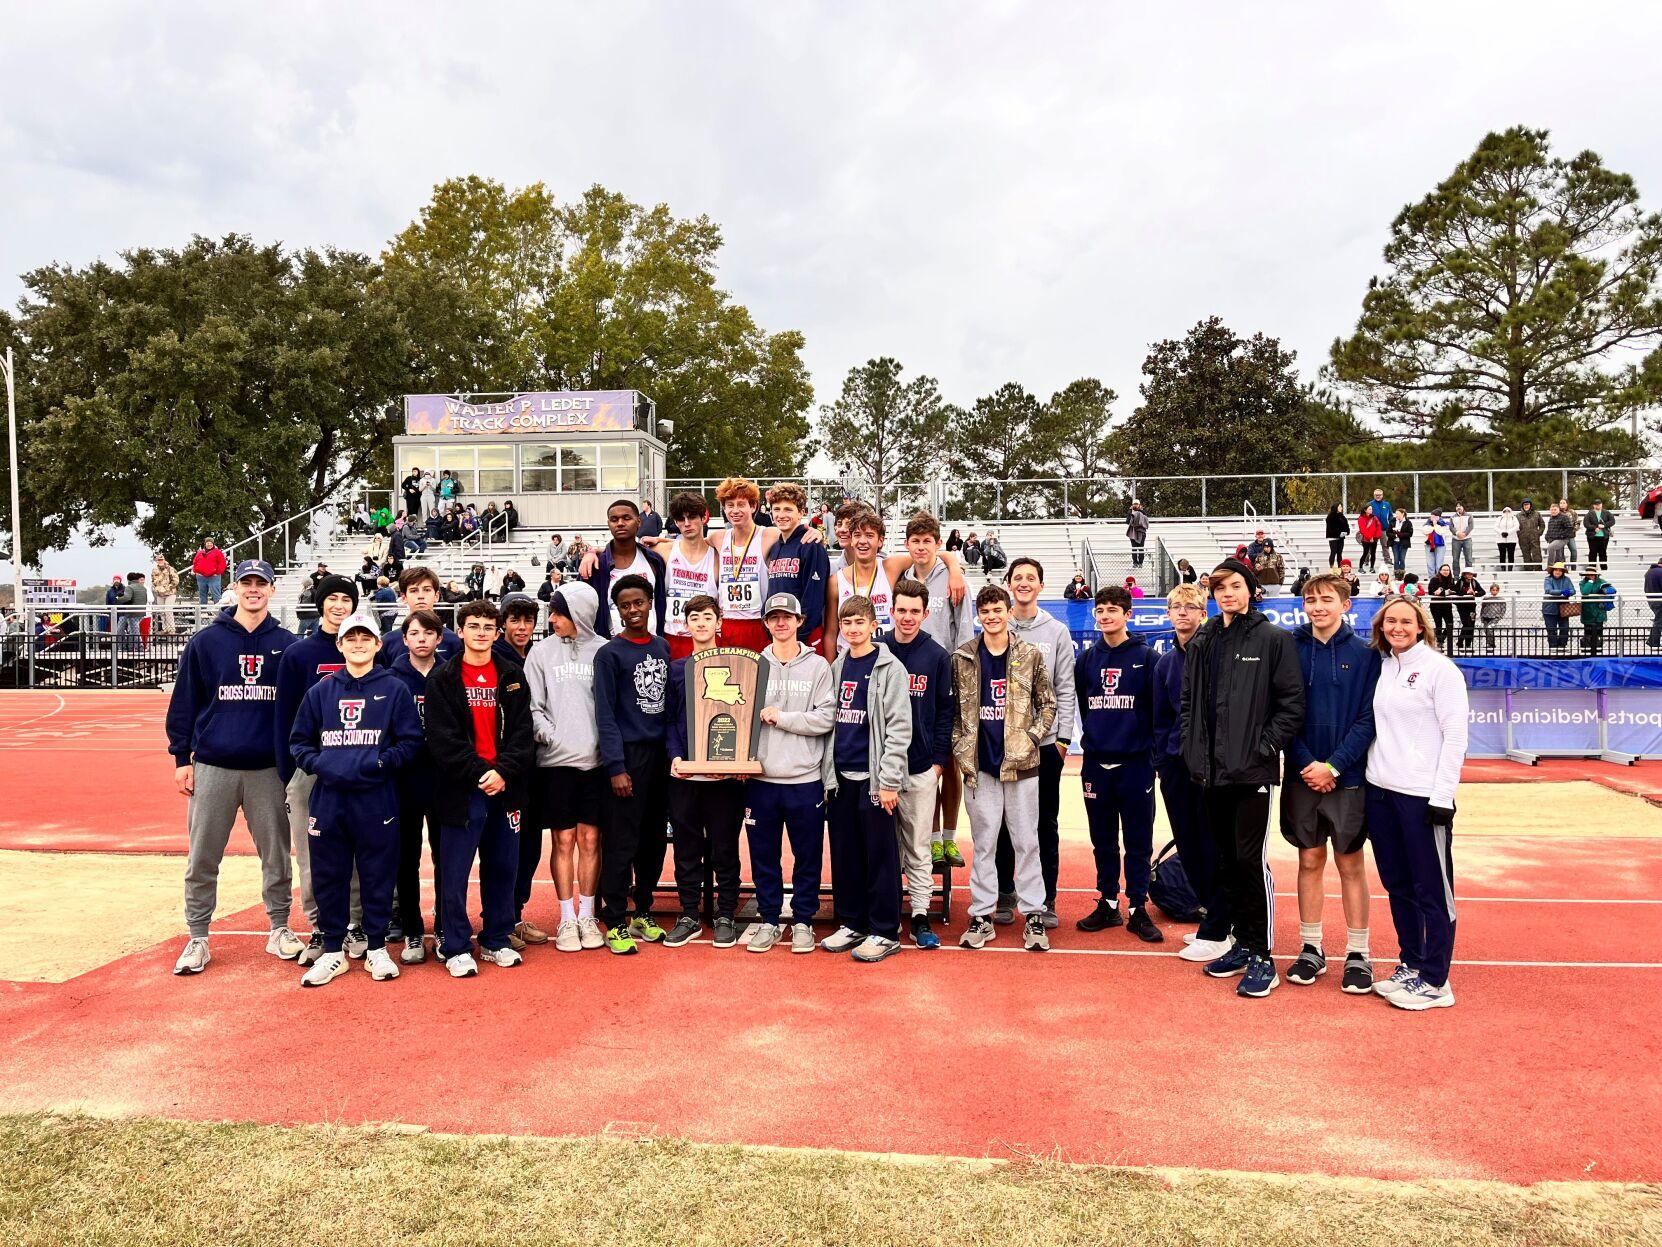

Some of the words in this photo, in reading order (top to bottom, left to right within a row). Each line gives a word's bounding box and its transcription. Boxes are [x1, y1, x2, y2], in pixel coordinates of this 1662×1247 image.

[445, 401, 515, 417] WALTER
[521, 401, 535, 412] P.
[541, 397, 594, 412] LEDET
[450, 416, 505, 432] TRACK
[509, 413, 590, 428] COMPLEX
[1261, 607, 1358, 626] Ocher
[693, 649, 719, 662] STATE
[719, 647, 761, 662] CHAMPION
[219, 685, 243, 701] CROSS
[244, 685, 277, 701] COUNTRY
[1104, 695, 1136, 710] COUNTRY
[321, 730, 343, 746] CROSS
[343, 729, 382, 746] COUNTRY
